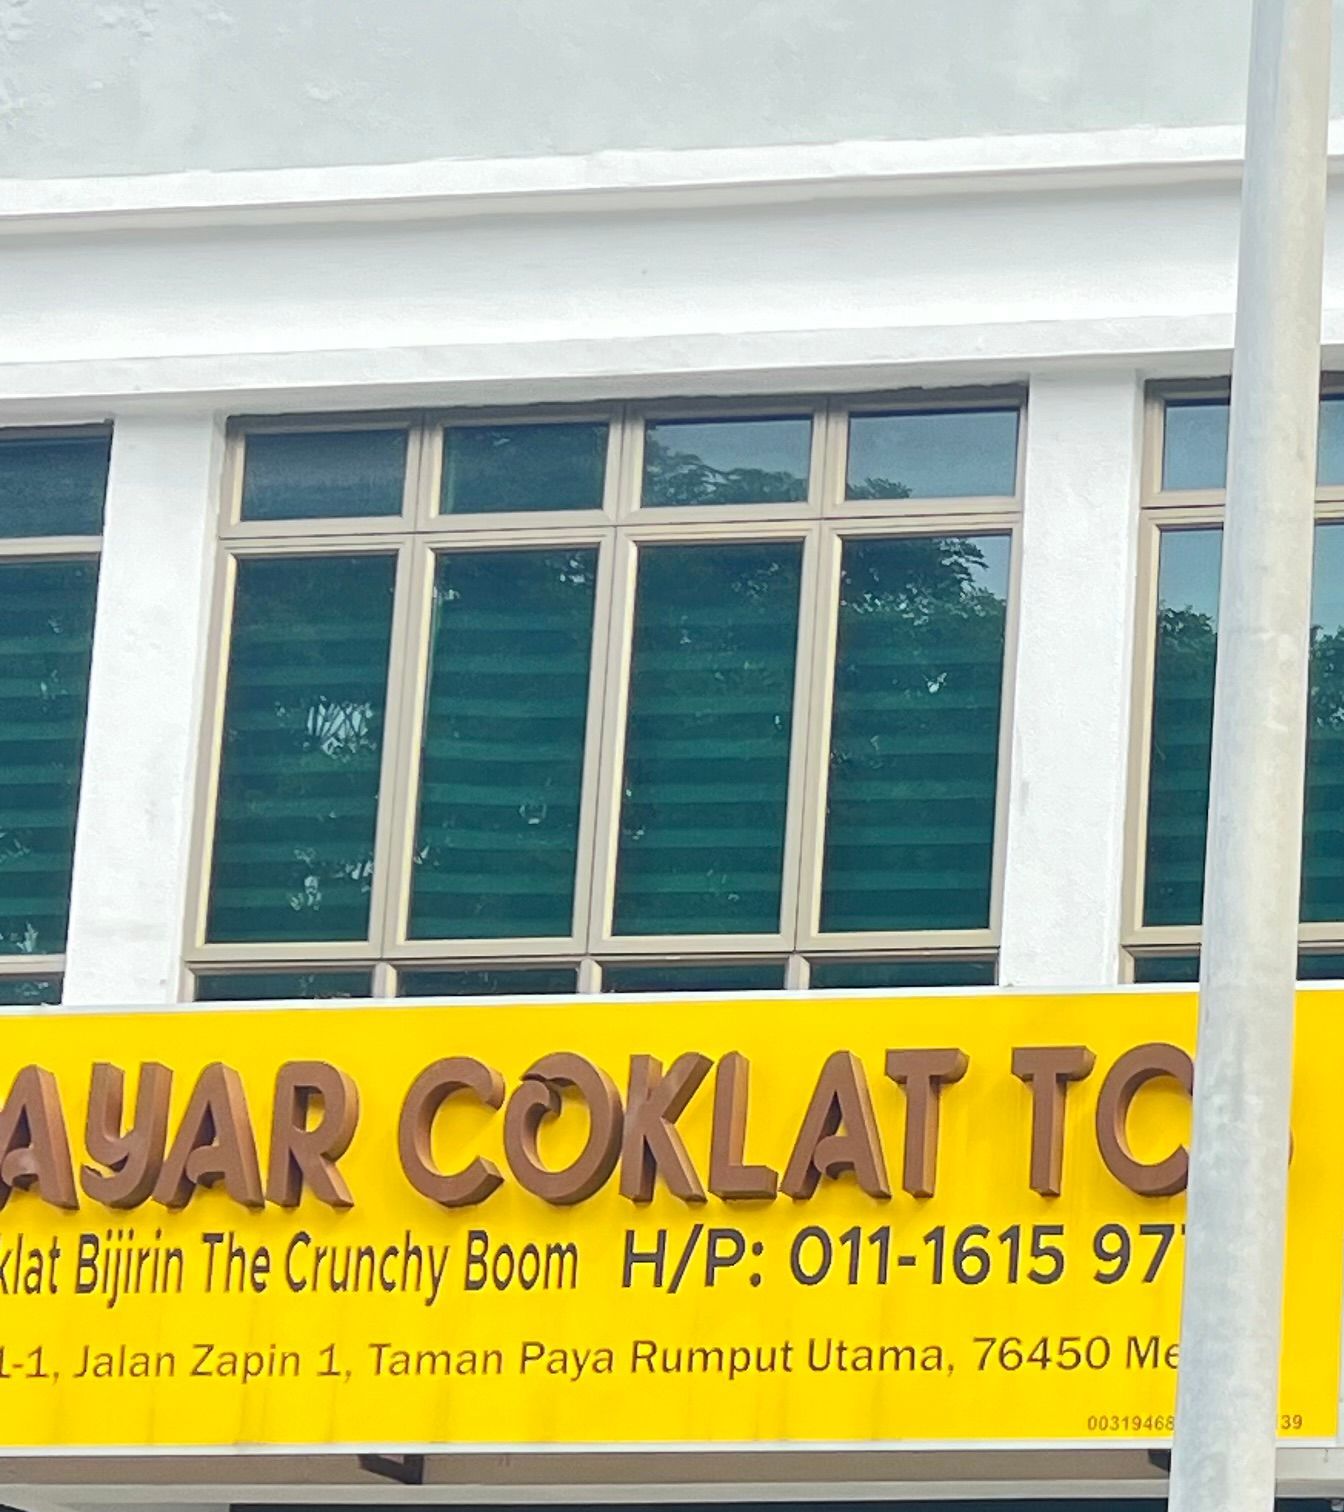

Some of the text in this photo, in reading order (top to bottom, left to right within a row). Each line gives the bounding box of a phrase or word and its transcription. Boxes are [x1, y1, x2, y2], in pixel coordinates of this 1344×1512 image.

[397, 1048, 970, 1207] COKLAT
[74, 1228, 185, 1308] Bijirin
[201, 1231, 271, 1293] The
[285, 1231, 450, 1306] Crunchy
[463, 1228, 578, 1291] Boom
[621, 1222, 765, 1293] H/P:
[789, 1222, 1065, 1286] 011-1615
[74, 1342, 176, 1379] Jalan
[189, 1343, 301, 1384] Zapin
[317, 1342, 352, 1385] 1,
[369, 1341, 503, 1378] Taman
[518, 1339, 614, 1381] Paya
[630, 1337, 793, 1381] Rumput
[807, 1336, 956, 1377] Utama,
[973, 1334, 1112, 1373] 76450
